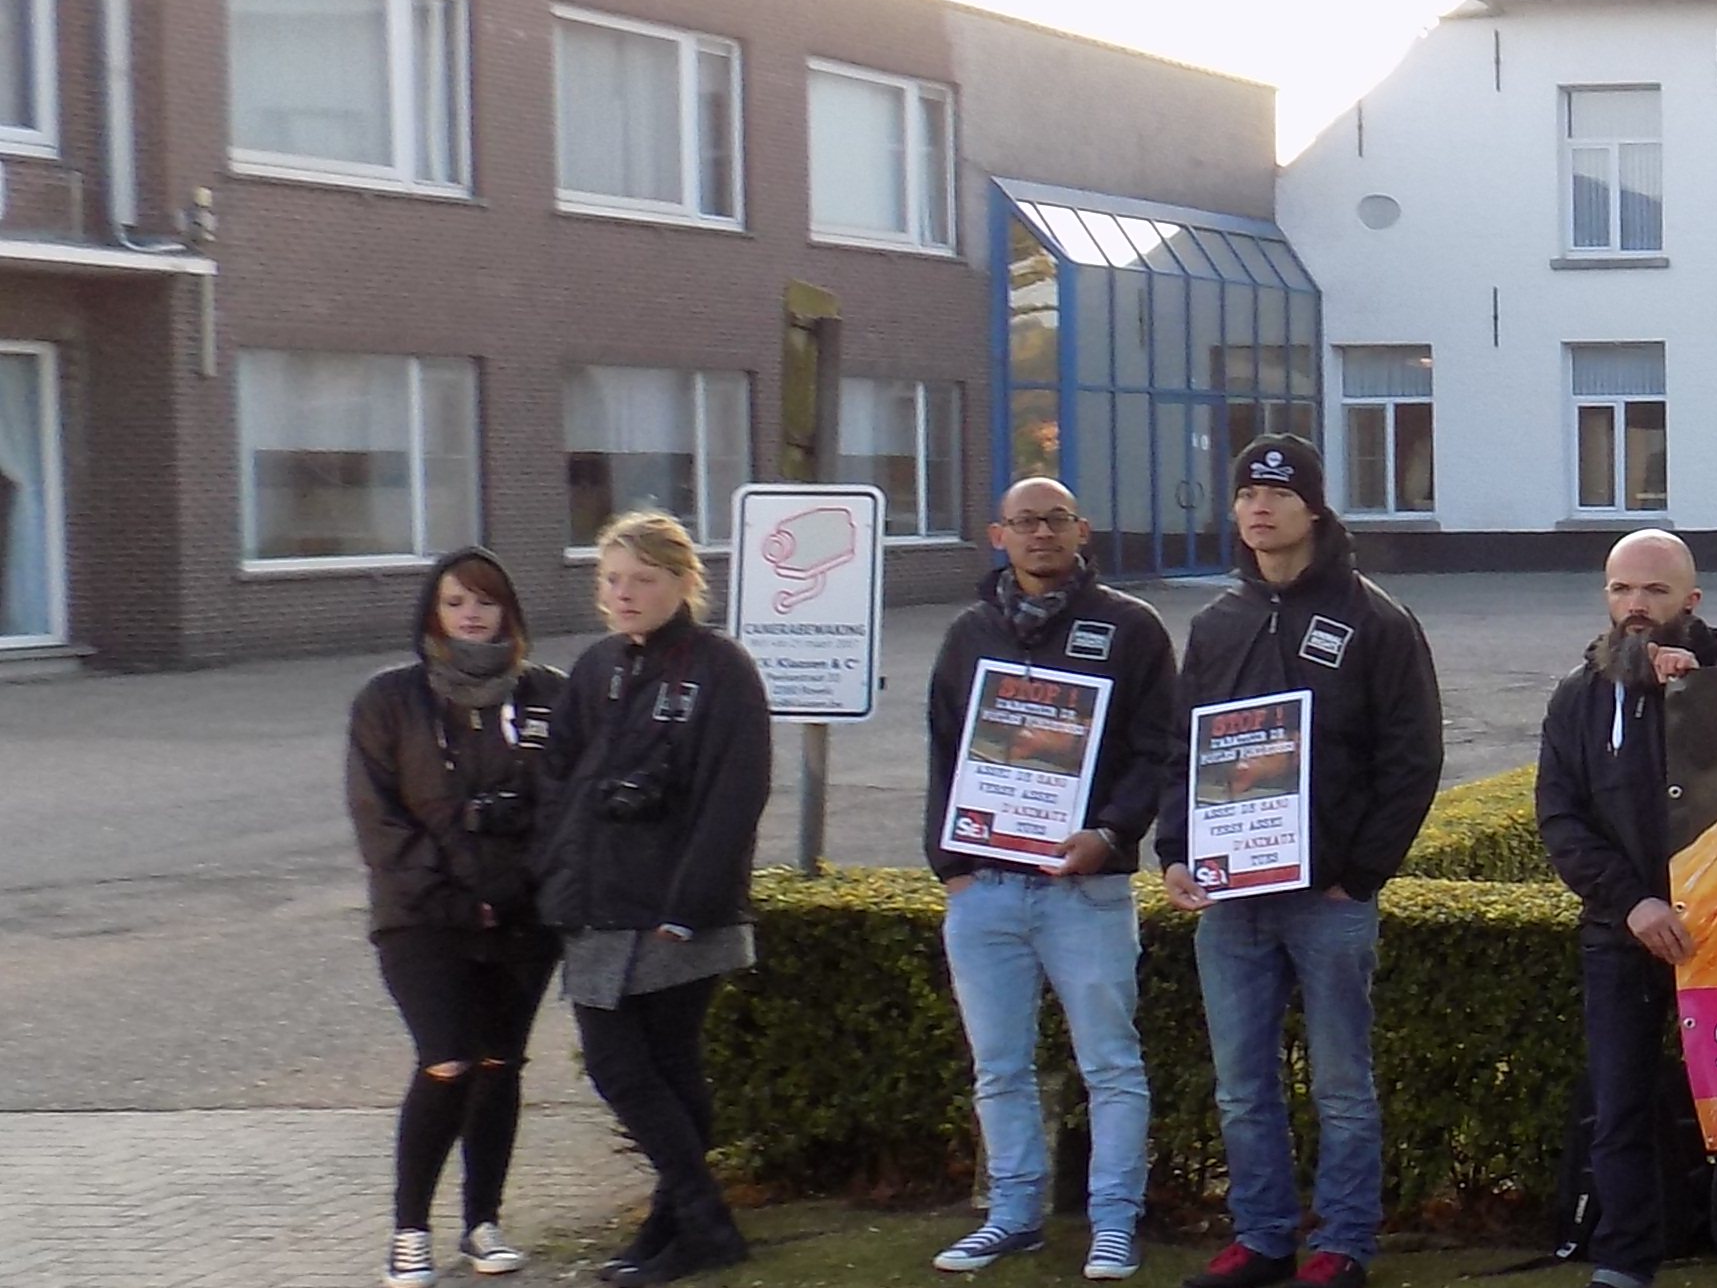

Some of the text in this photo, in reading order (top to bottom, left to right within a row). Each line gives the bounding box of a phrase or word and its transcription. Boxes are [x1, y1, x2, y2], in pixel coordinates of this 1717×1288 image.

[744, 623, 866, 636] CAMERABEWAKING
[998, 676, 1060, 704] STOP
[1212, 709, 1266, 736] STOP
